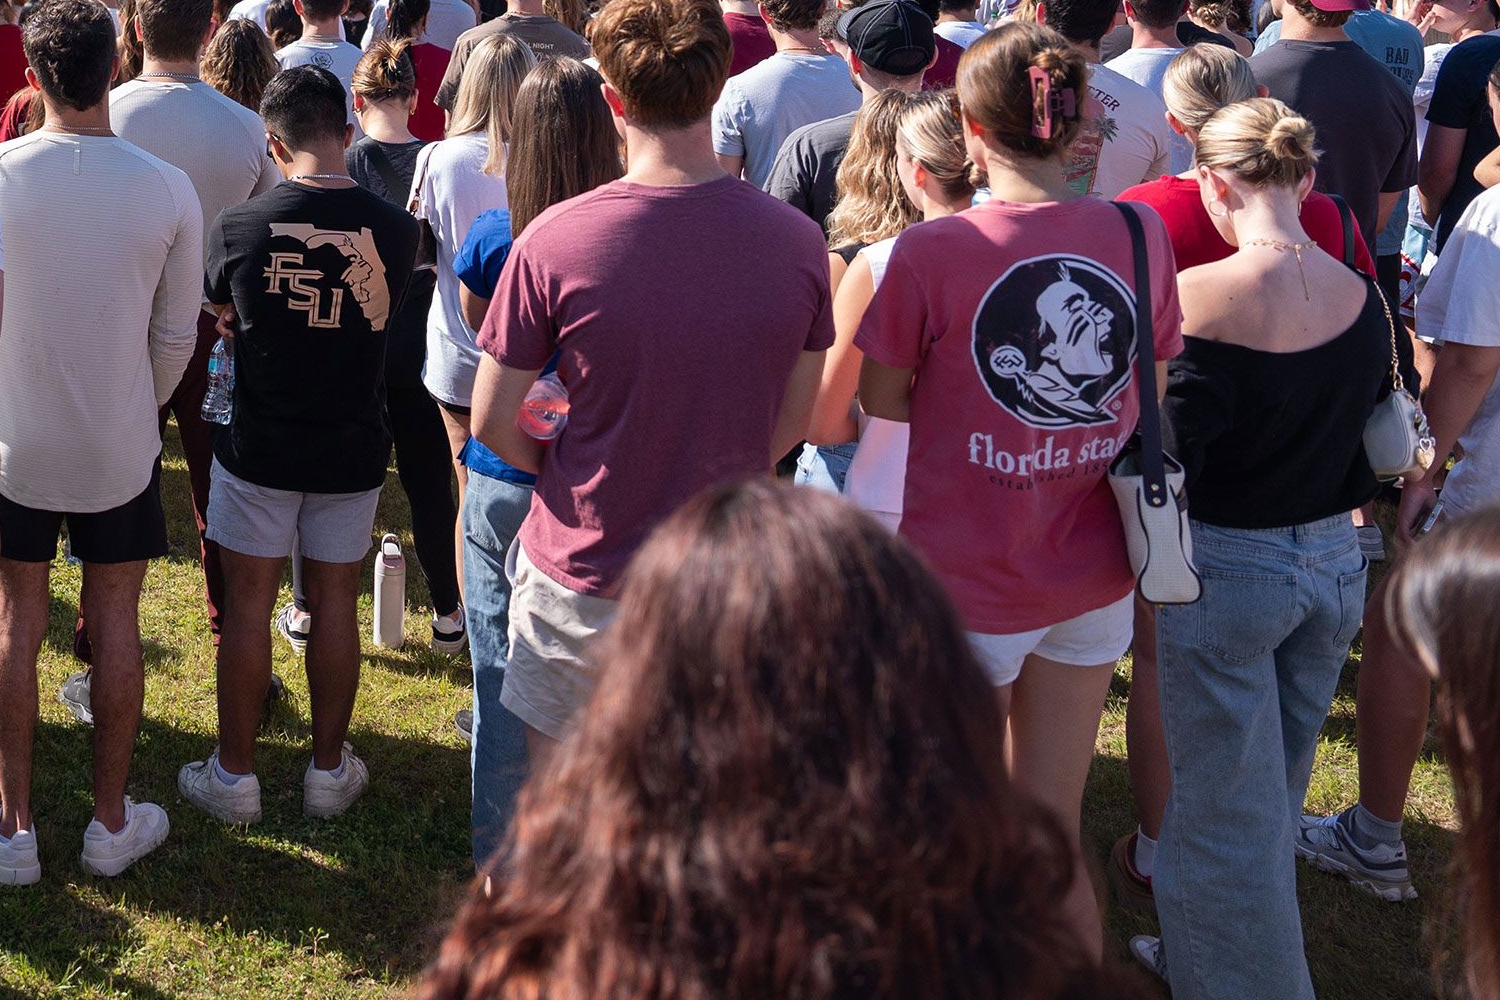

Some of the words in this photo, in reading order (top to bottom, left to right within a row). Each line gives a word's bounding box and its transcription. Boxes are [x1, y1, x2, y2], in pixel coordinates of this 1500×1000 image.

[1385, 46, 1410, 66] BAD
[262, 252, 344, 329] FSU
[993, 353, 1024, 369] FSU
